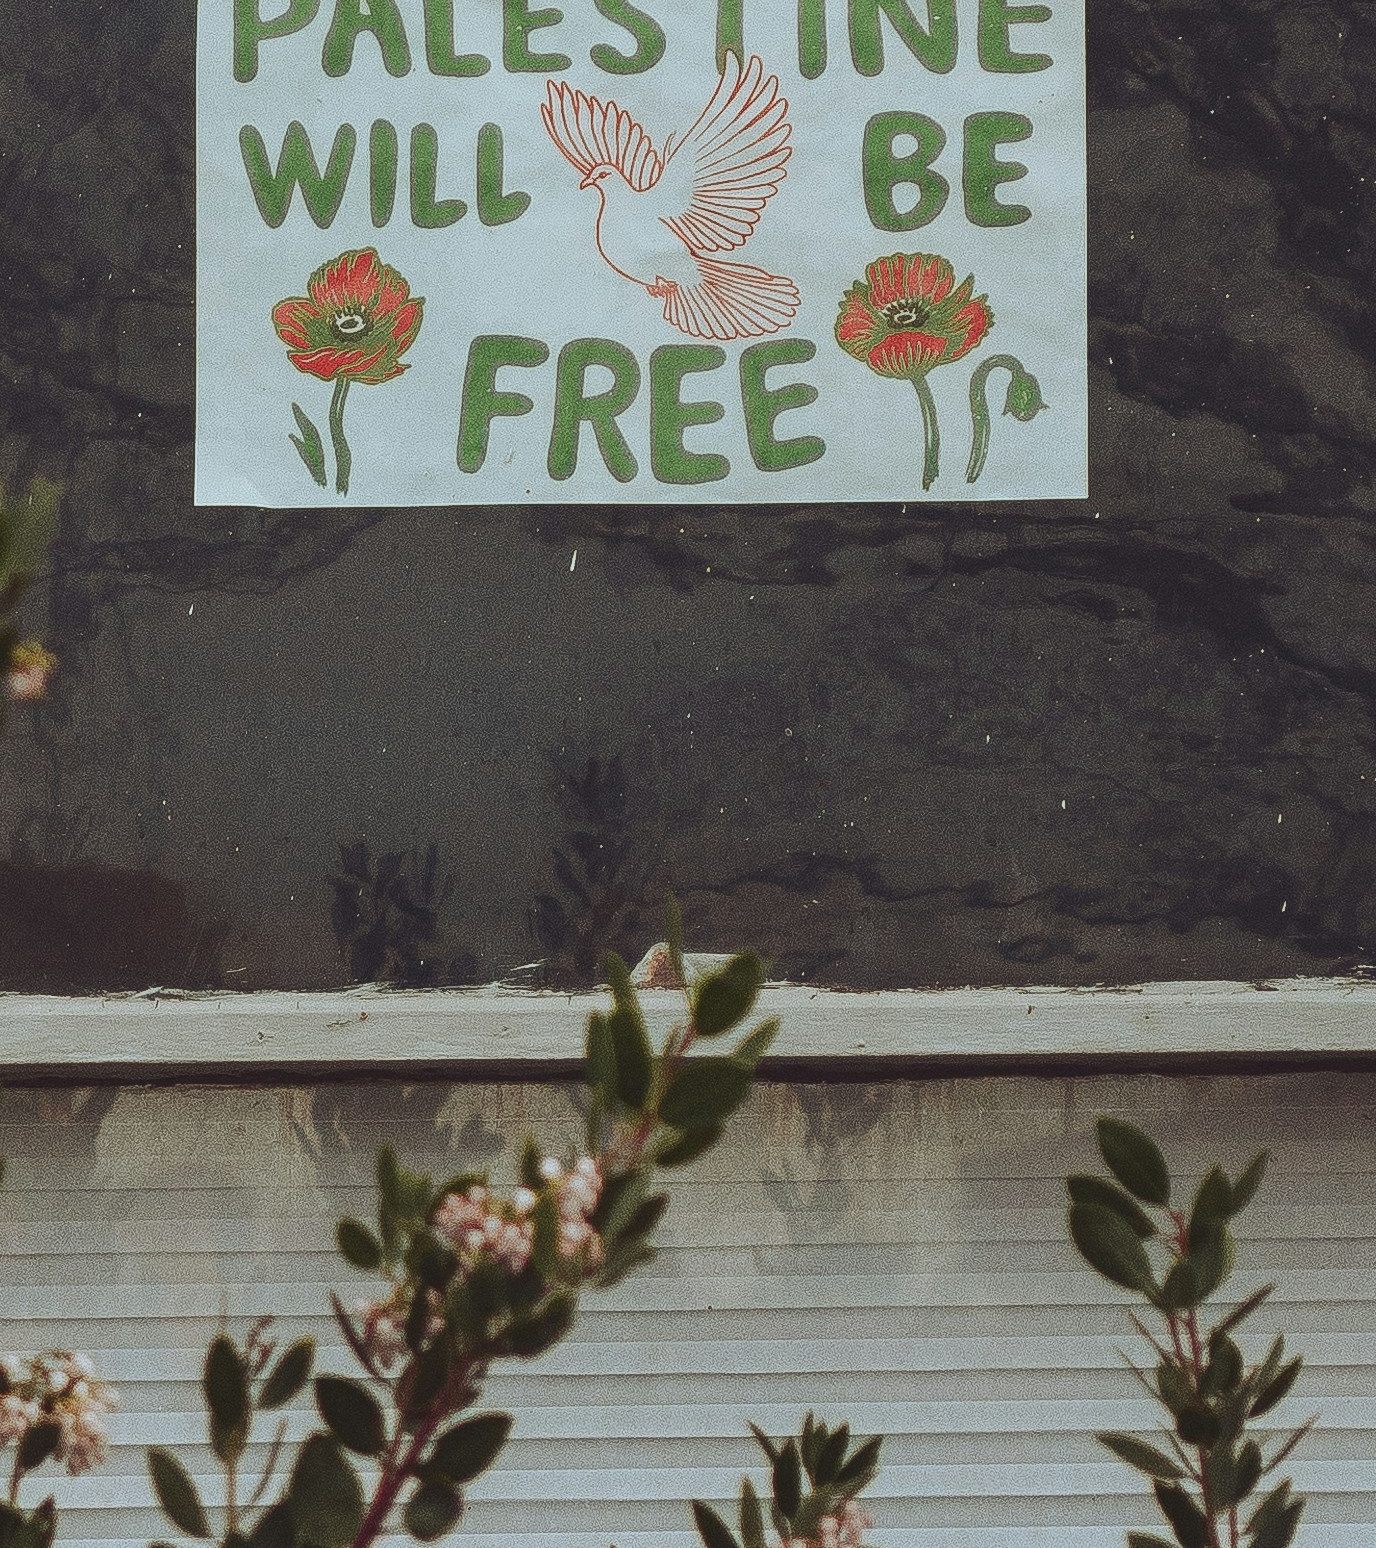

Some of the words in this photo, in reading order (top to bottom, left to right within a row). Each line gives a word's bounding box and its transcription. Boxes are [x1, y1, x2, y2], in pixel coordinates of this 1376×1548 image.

[239, 118, 531, 230] WILL
[862, 110, 1034, 231] BE
[456, 335, 827, 485] FREE
